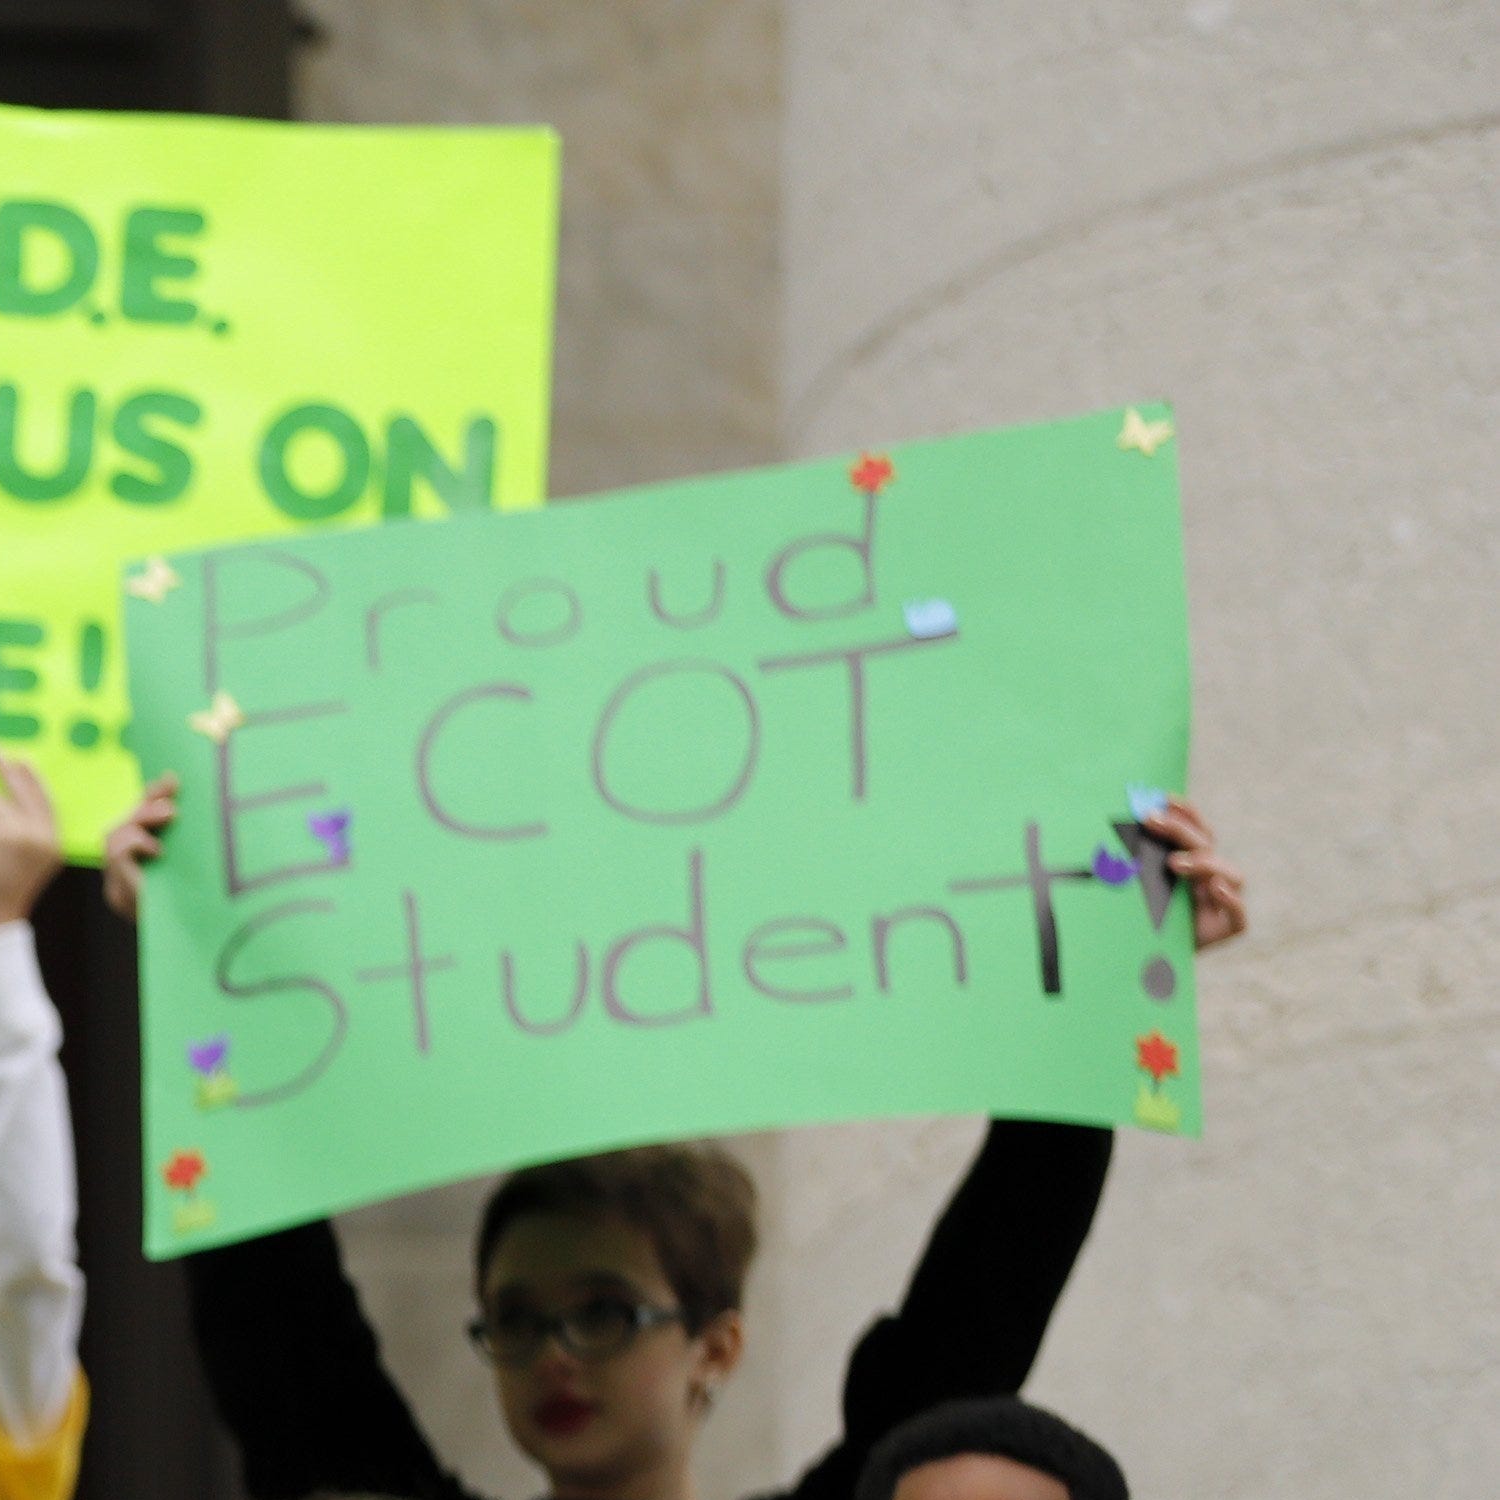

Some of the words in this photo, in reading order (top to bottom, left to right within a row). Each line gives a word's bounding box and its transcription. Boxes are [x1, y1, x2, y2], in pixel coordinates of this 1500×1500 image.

[257, 401, 499, 524] ON
[200, 488, 880, 694] Proud
[213, 628, 960, 898] ECOT
[212, 820, 1178, 1110] Student!
